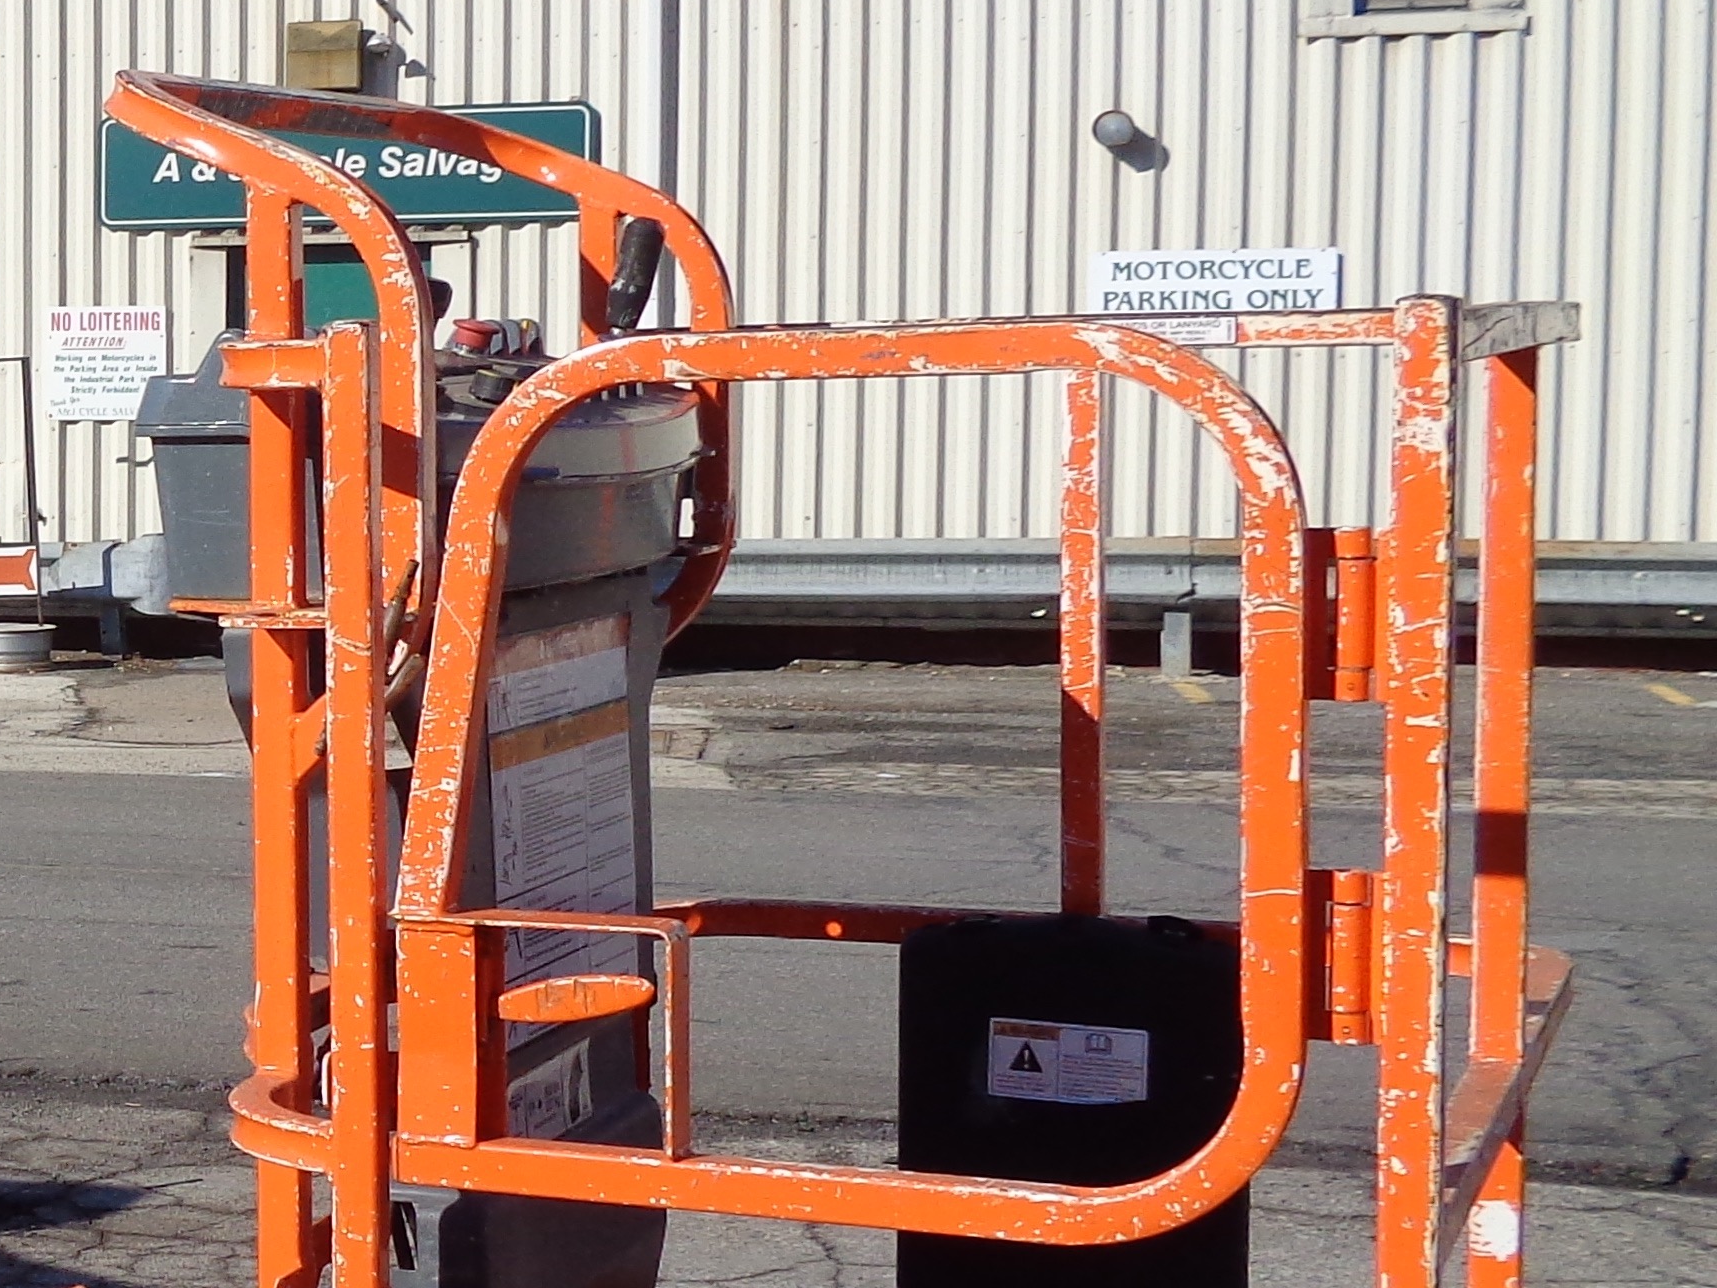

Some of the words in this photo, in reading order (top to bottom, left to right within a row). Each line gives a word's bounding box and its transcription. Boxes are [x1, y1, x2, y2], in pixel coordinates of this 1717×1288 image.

[153, 152, 180, 183] A
[191, 161, 217, 182] &
[378, 146, 502, 183] Salvag
[1111, 258, 1313, 281] MOTORCYCLE
[1103, 290, 1232, 310] PARKING
[1247, 289, 1323, 309] ONLY
[51, 312, 71, 331] NO
[80, 312, 160, 331] LOITERING
[70, 365, 97, 373] Parking
[112, 408, 136, 416] SALV
